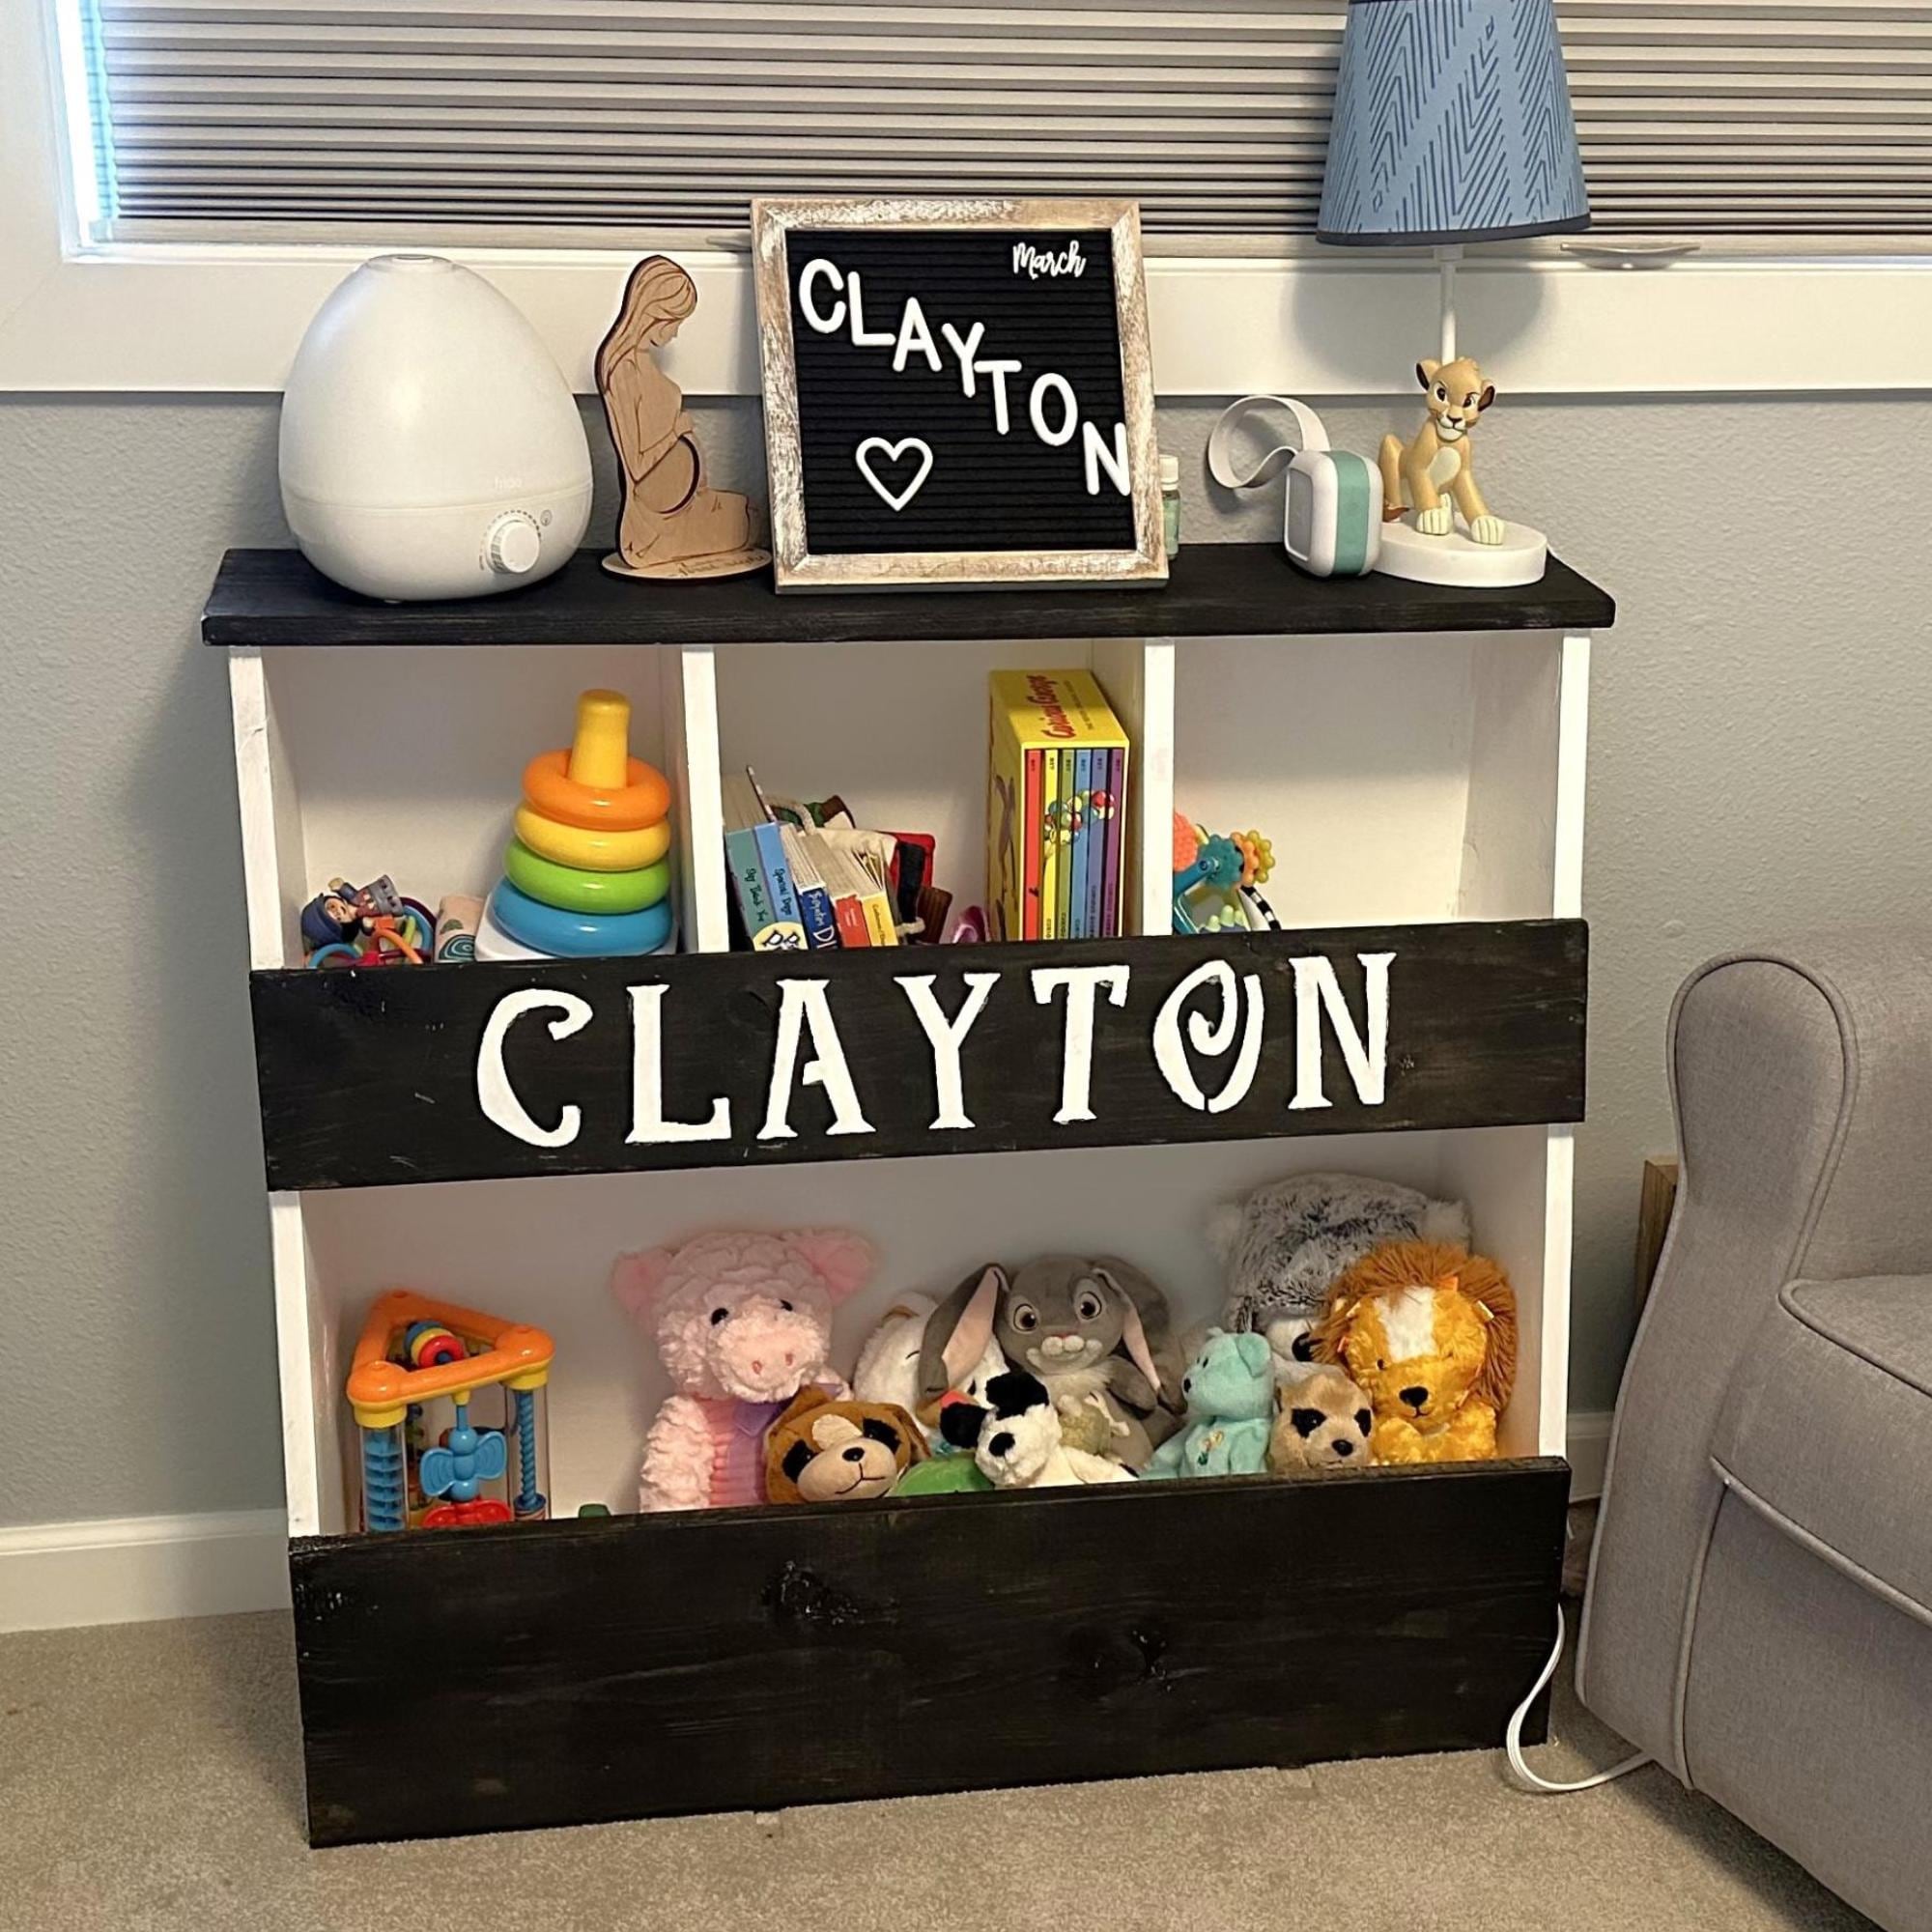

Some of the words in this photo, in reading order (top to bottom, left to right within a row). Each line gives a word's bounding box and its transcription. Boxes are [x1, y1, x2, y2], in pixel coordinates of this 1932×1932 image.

[1012, 240, 1087, 280] March
[798, 258, 1131, 497] CLAYTON
[475, 952, 1397, 1149] CLAYTON
